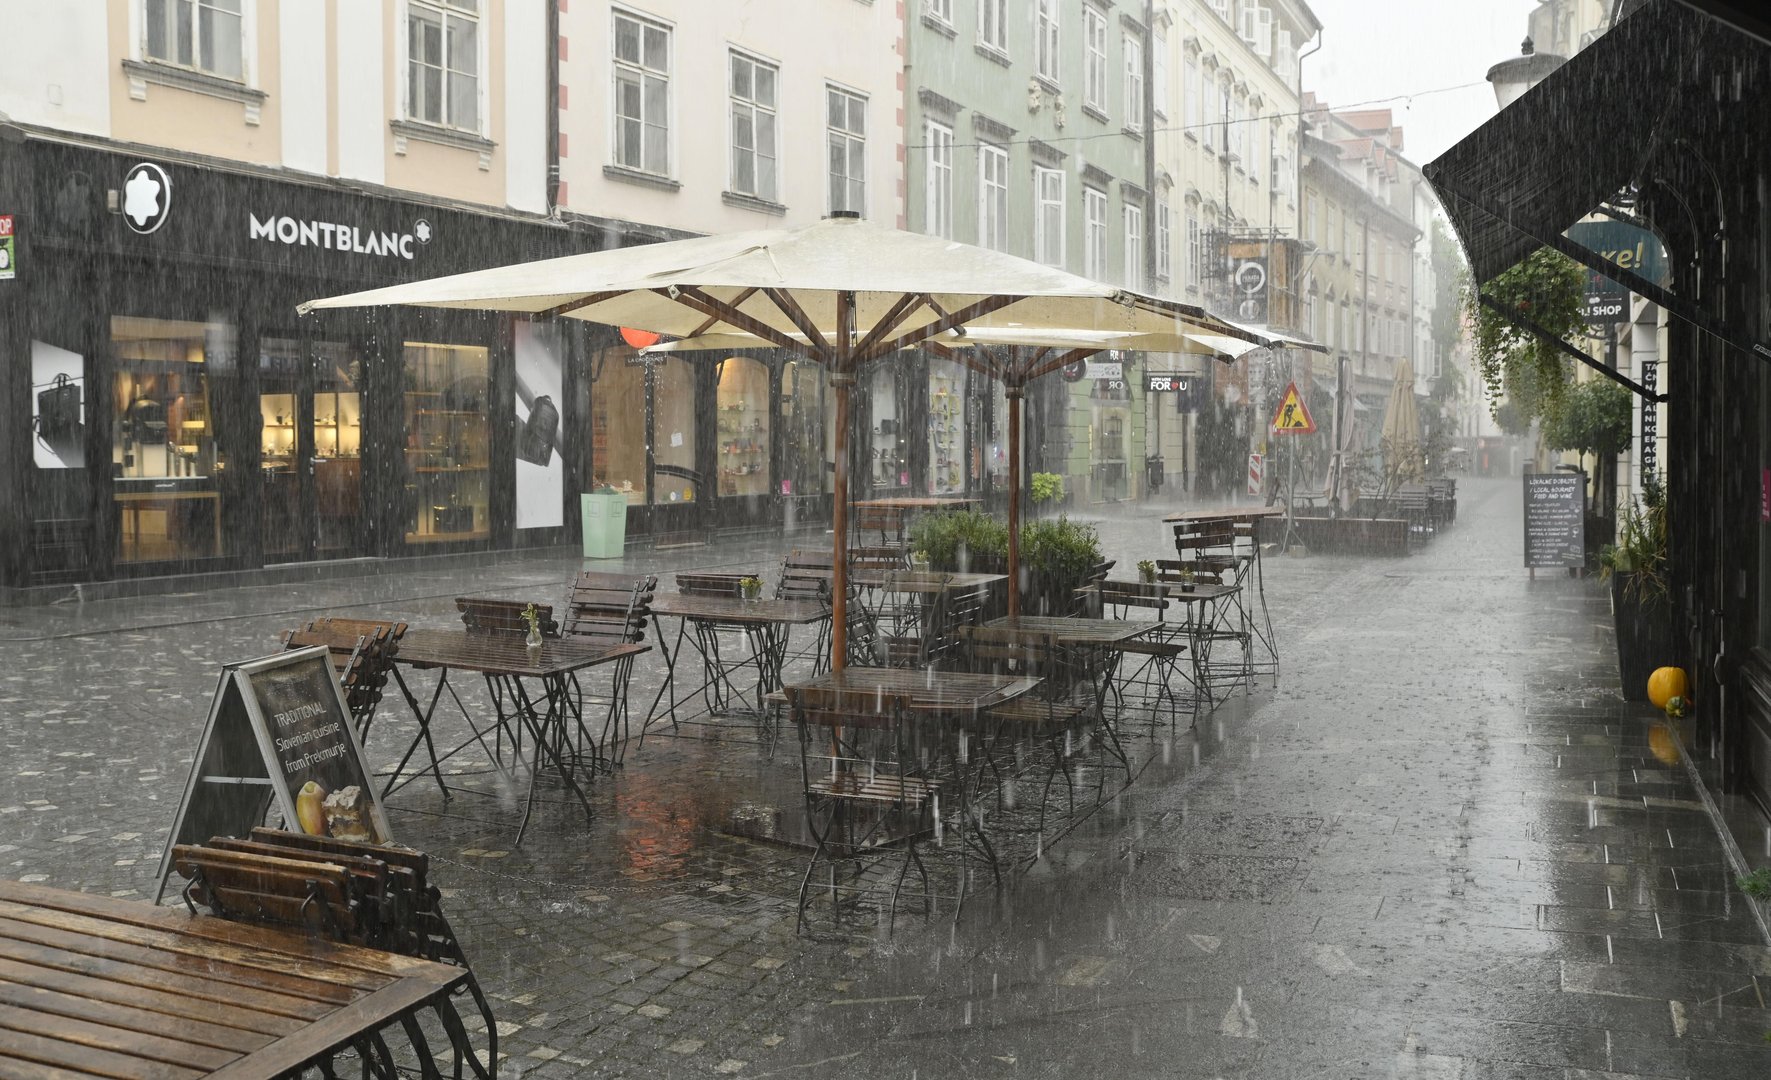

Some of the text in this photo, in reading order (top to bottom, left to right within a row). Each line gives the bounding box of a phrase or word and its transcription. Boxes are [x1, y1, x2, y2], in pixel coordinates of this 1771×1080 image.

[250, 212, 413, 260] MONTBLANC
[1593, 305, 1622, 316] SHOP
[1150, 381, 1171, 391] FOR
[274, 702, 327, 727] TRADITIONAL
[276, 722, 340, 752] Slovenian cuisine
[286, 741, 346, 773] from Prekmurje
